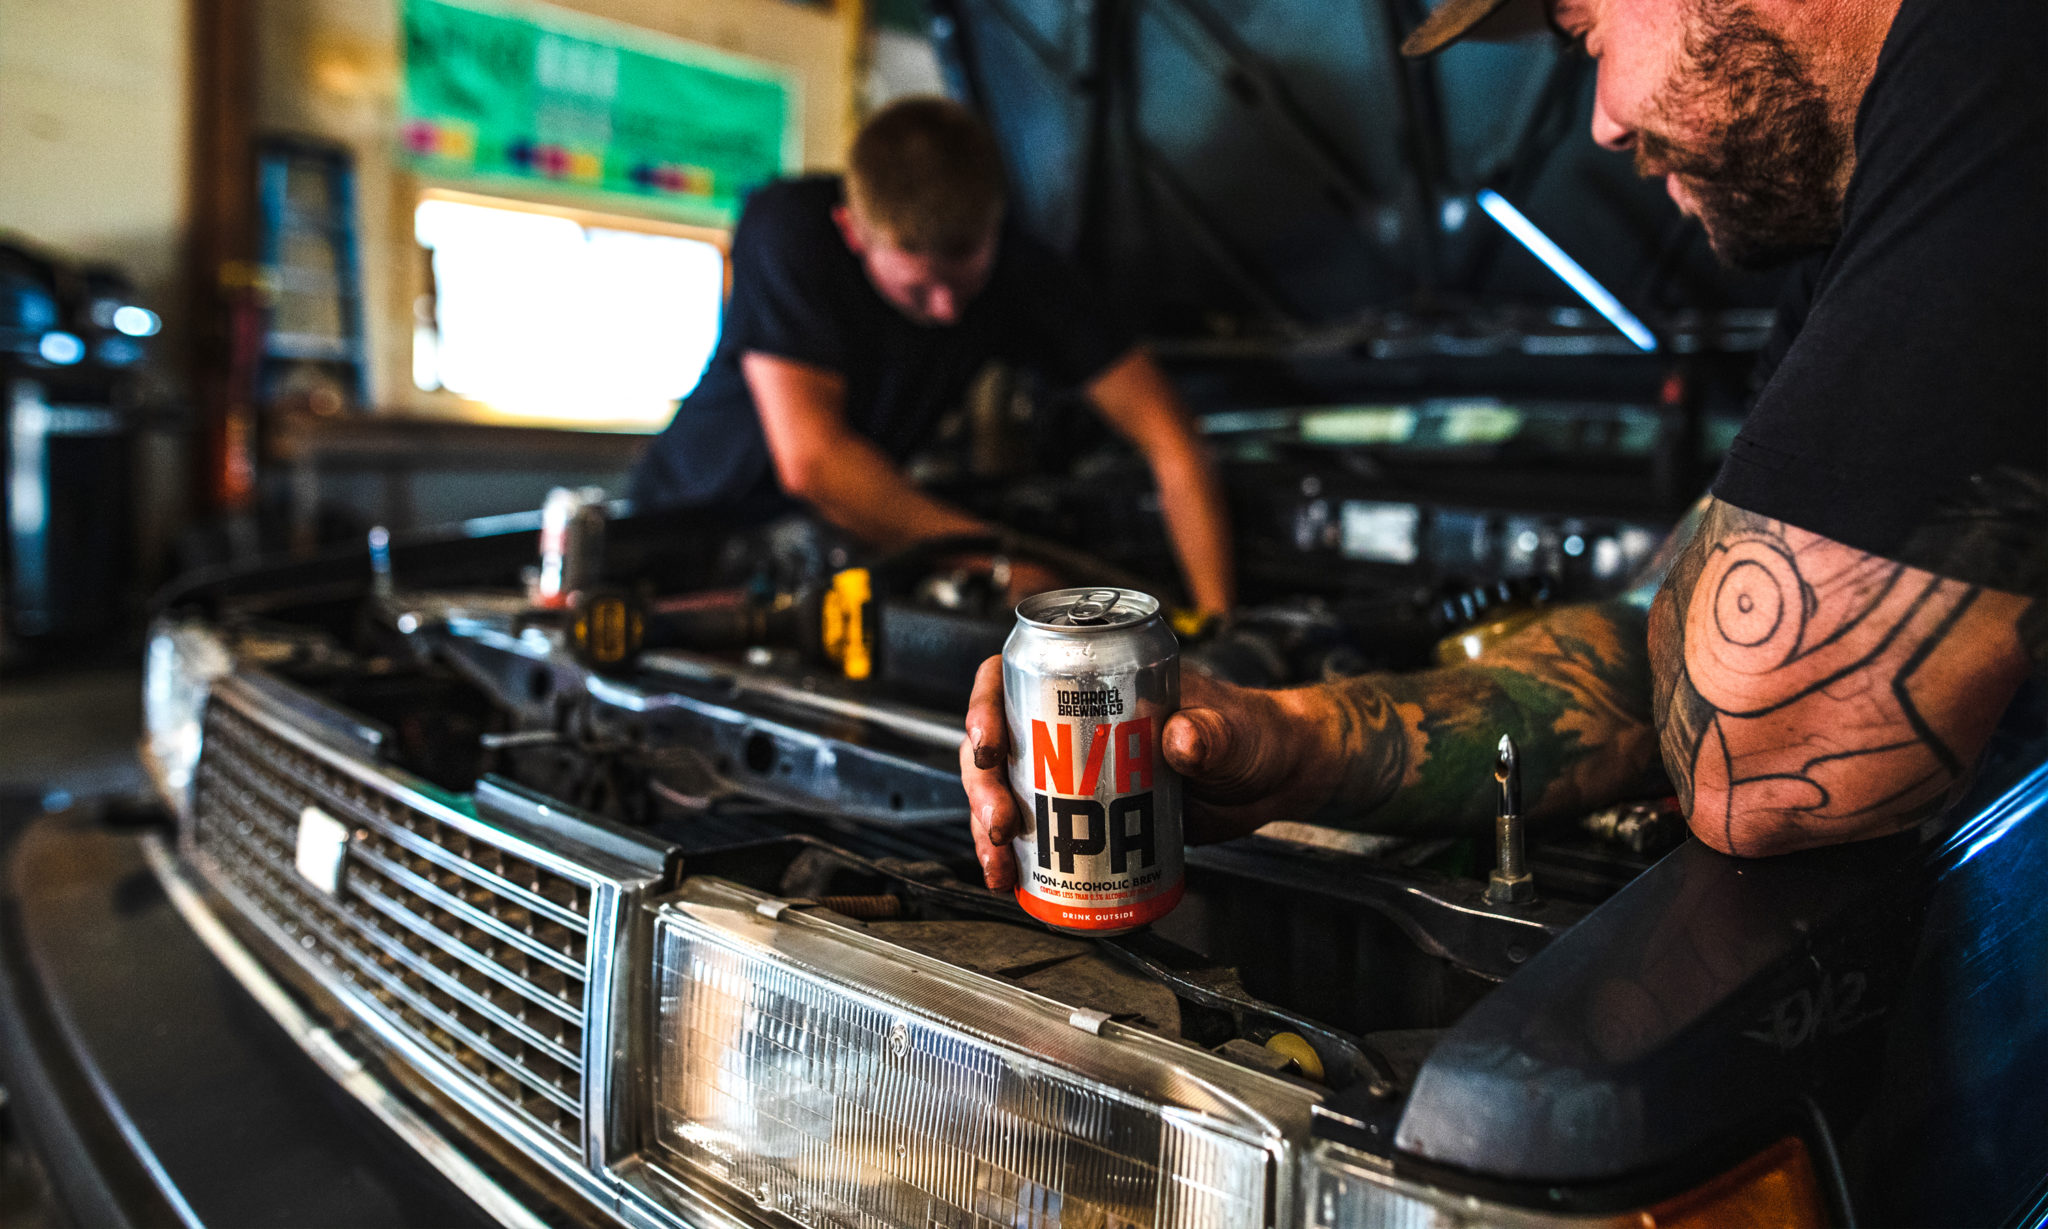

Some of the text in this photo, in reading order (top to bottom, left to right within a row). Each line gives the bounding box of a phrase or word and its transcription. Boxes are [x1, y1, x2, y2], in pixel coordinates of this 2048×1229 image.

[1032, 716, 1153, 796] N/A
[1035, 791, 1156, 874] IPA
[1032, 871, 1129, 891] NON-ALCOHOLIC
[1133, 869, 1162, 887] BREW
[1062, 891, 1074, 899] LESS
[1075, 892, 1089, 901] THAN
[1062, 911, 1134, 921] DRINK OUTSIDE
